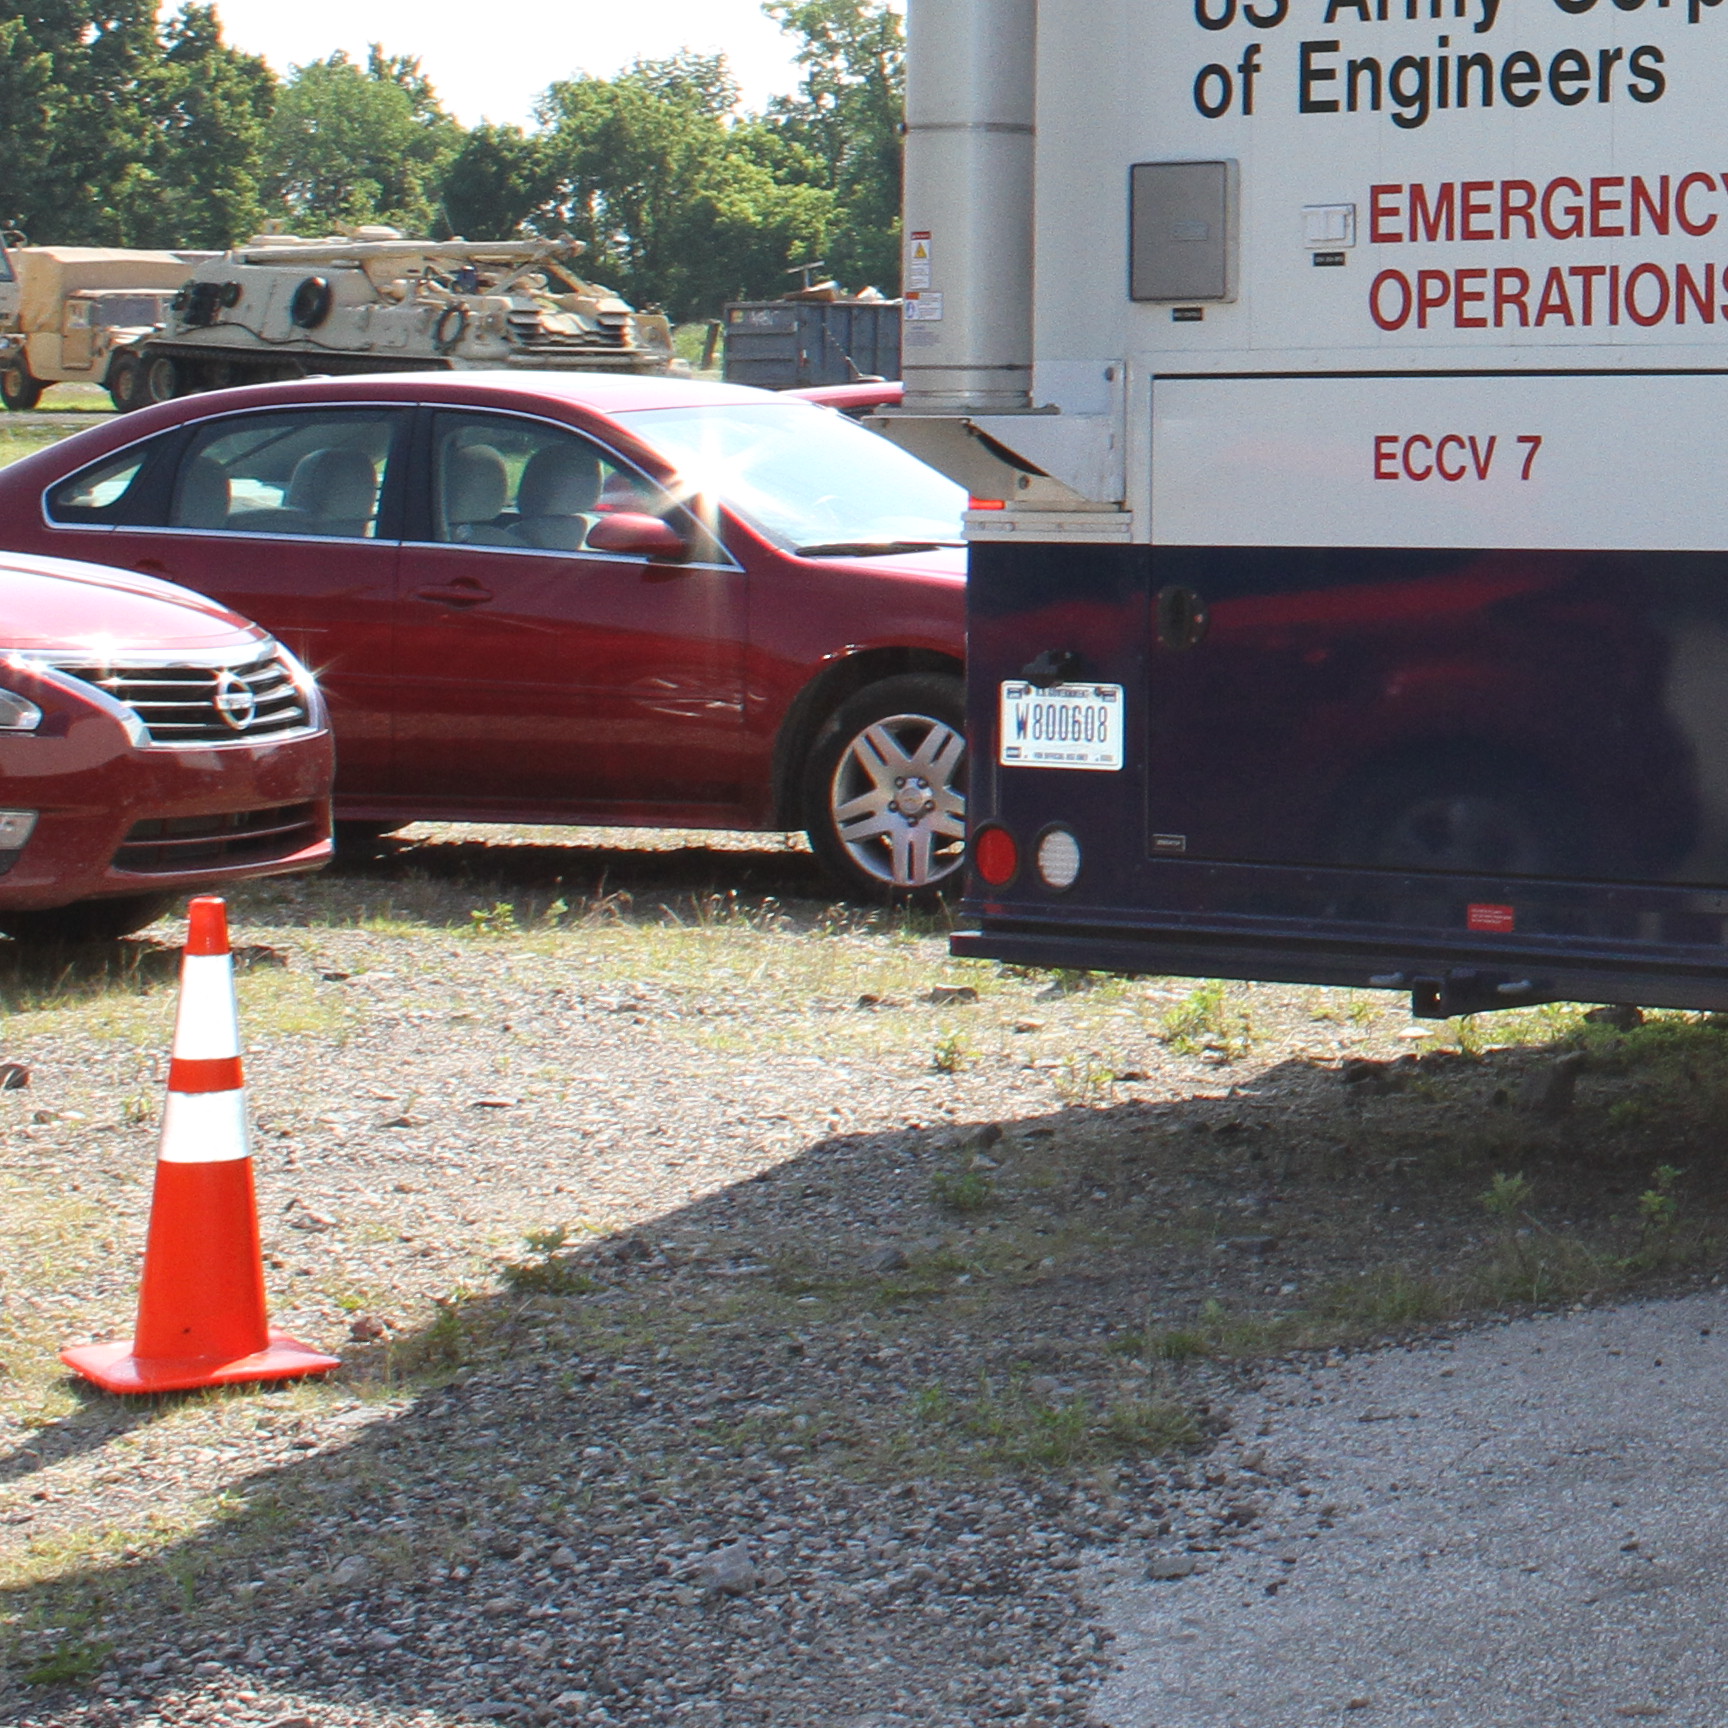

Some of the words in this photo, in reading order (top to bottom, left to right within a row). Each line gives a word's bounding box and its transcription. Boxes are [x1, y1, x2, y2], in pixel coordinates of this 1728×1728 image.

[1193, 43, 1262, 119] of
[1299, 34, 1666, 130] Engineers
[1375, 434, 1497, 482] ECCV
[1518, 435, 1542, 481] 7
